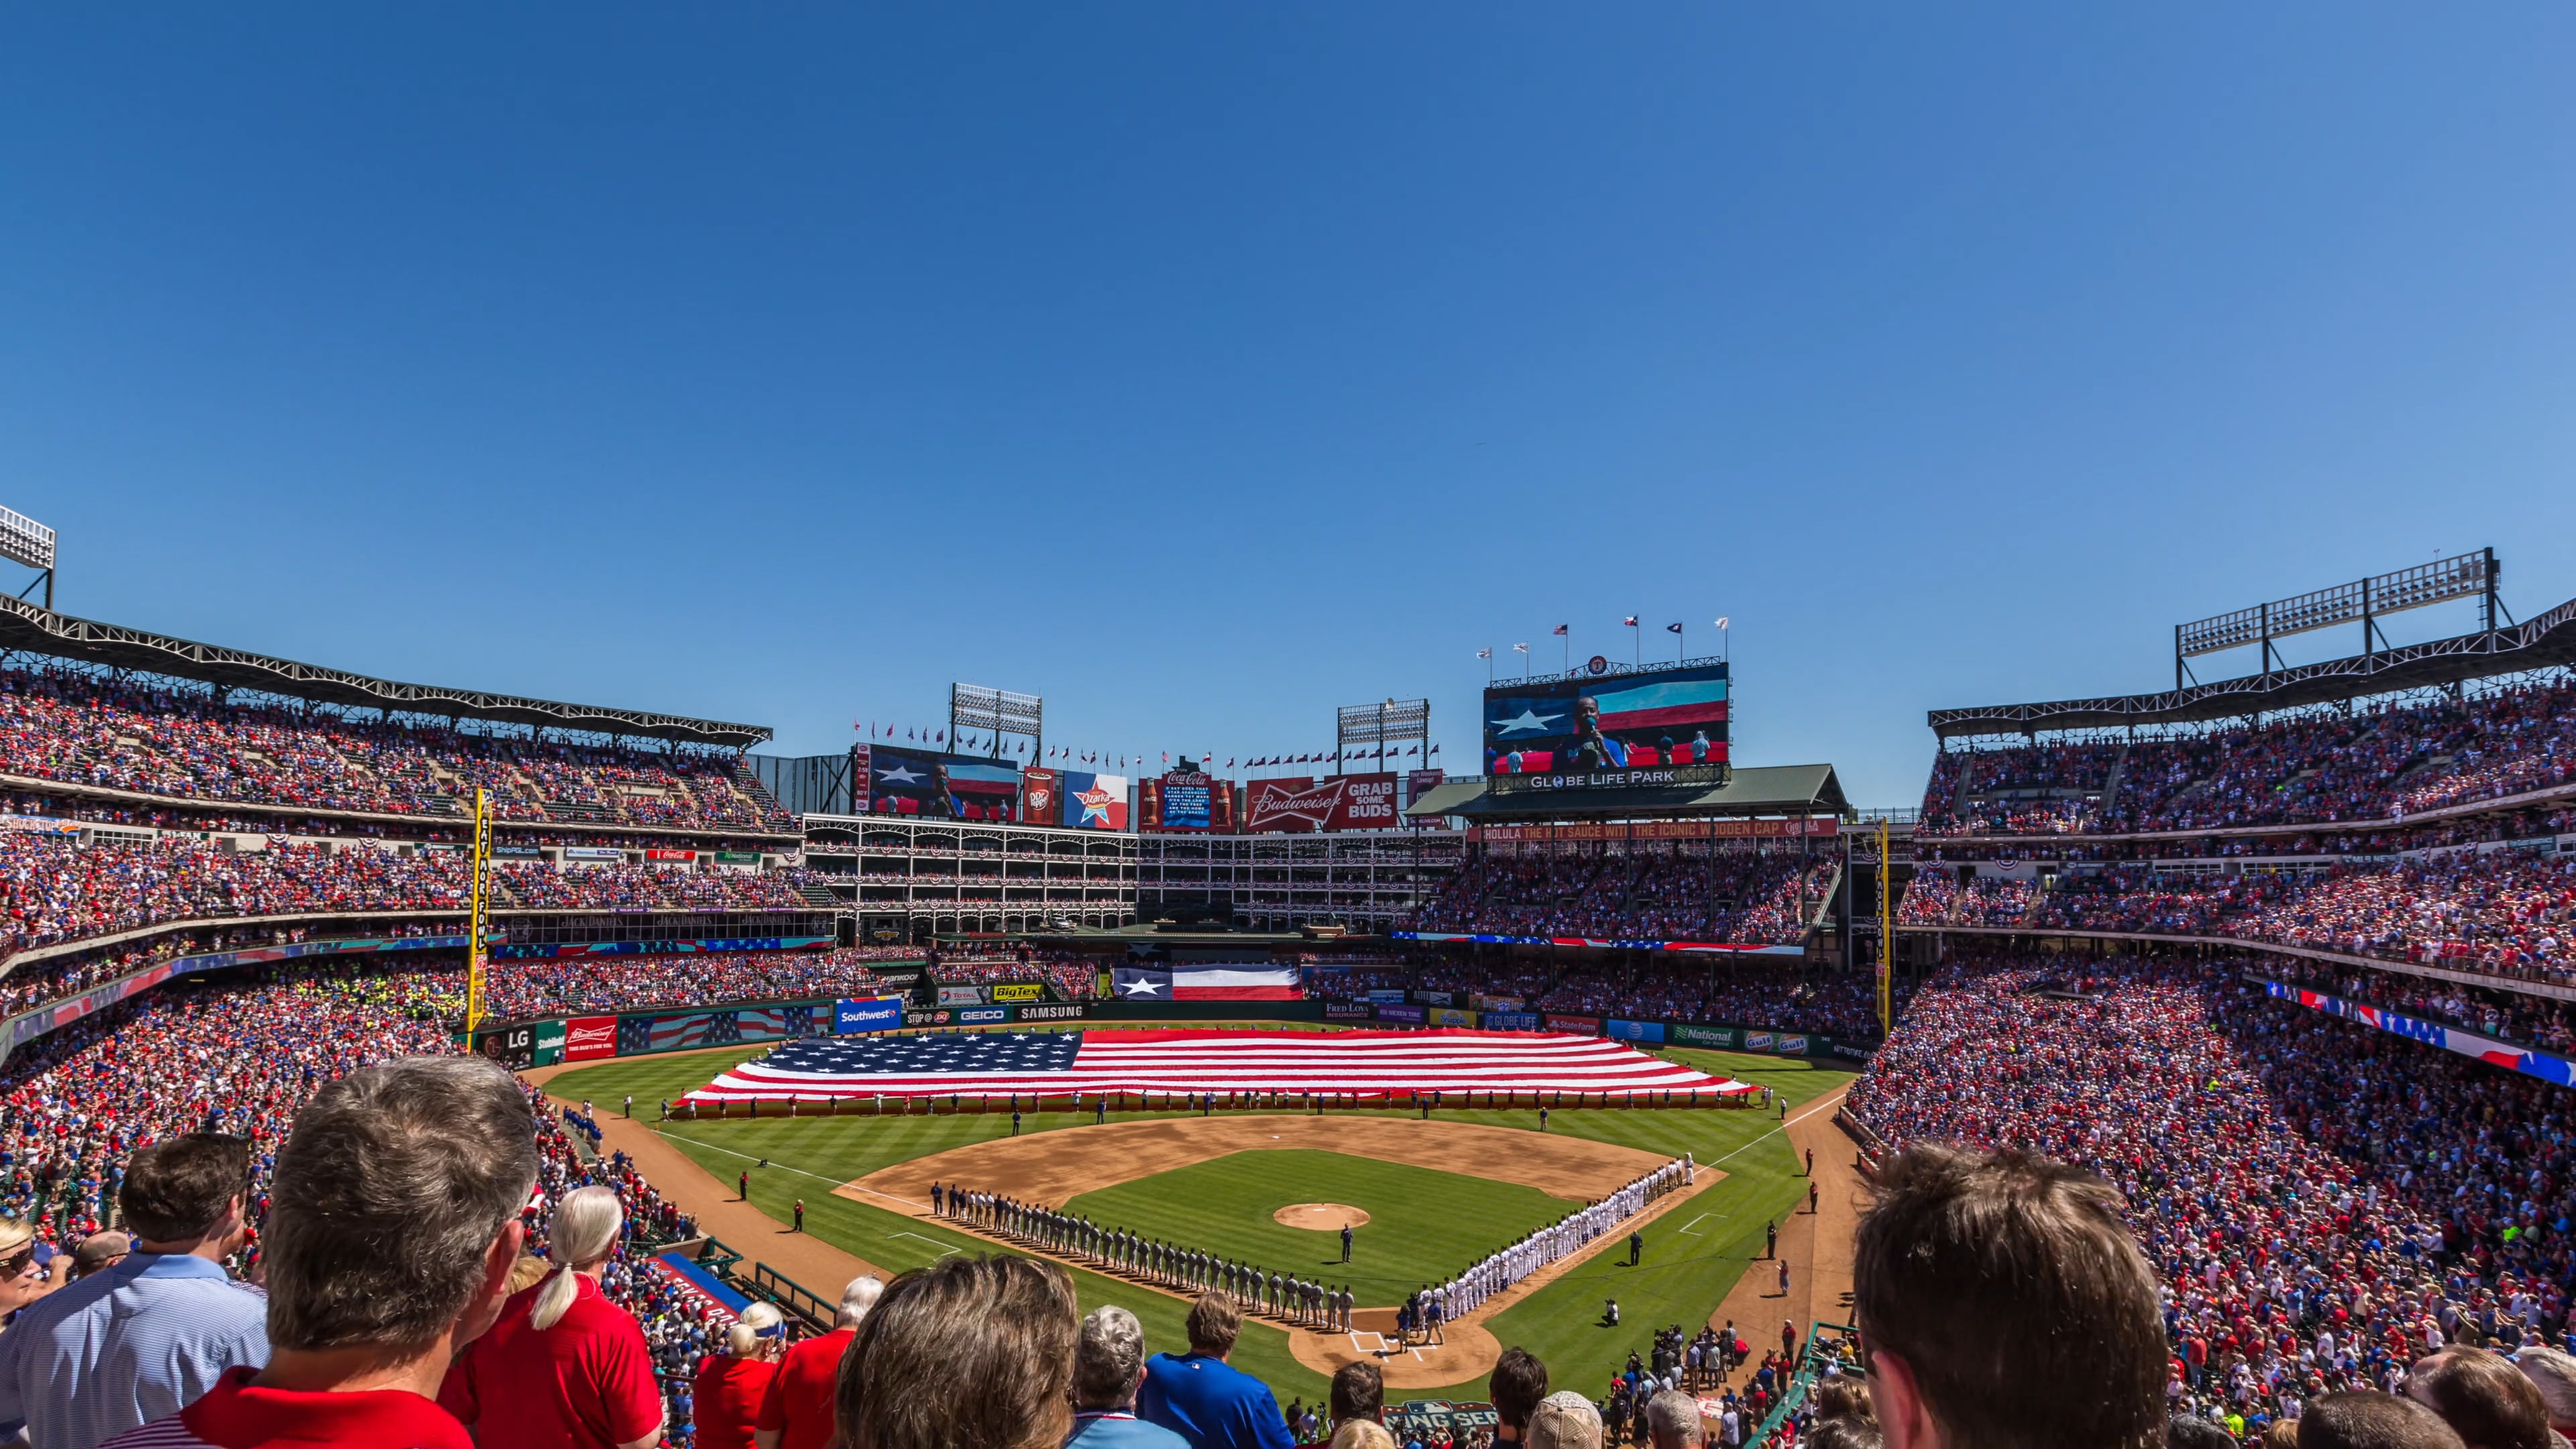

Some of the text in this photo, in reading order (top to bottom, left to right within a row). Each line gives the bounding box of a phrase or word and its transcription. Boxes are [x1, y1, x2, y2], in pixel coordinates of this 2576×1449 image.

[1167, 771, 1207, 785] Coca-Cola
[1531, 771, 1674, 788] GLOBE LIFE PARK
[1348, 782, 1393, 797] GRAB
[1082, 793, 1110, 804] Ozarka
[1252, 794, 1342, 813] Budweiser
[1356, 796, 1385, 805] SOME
[1348, 804, 1392, 818] BUDS
[1524, 828, 1542, 839] THE
[1568, 826, 1601, 837] SAUCE
[1635, 825, 1655, 836] THE
[1659, 824, 1696, 836] ICONIC
[1755, 821, 1779, 835] CAP
[663, 851, 686, 859] Coca-Cola
[479, 859, 487, 896] MOR
[477, 902, 486, 949] FOWL
[561, 915, 585, 926] JACK
[657, 915, 678, 926] JACK
[1326, 1004, 1368, 1012] FRED LOYA
[1483, 997, 1525, 1012] DraKin
[841, 1009, 890, 1022] Southwest
[961, 1010, 1004, 1020] GEICO
[1022, 1006, 1082, 1018] SAMSUNG
[908, 1014, 924, 1024] STOP
[1440, 1015, 1467, 1025] Snapple
[1495, 1016, 1536, 1027] GLOBE LIFE
[508, 1030, 529, 1049] LG
[1687, 1029, 1732, 1041] National
[1747, 1036, 1772, 1047] Gulf
[1780, 1040, 1805, 1050] Gulf
